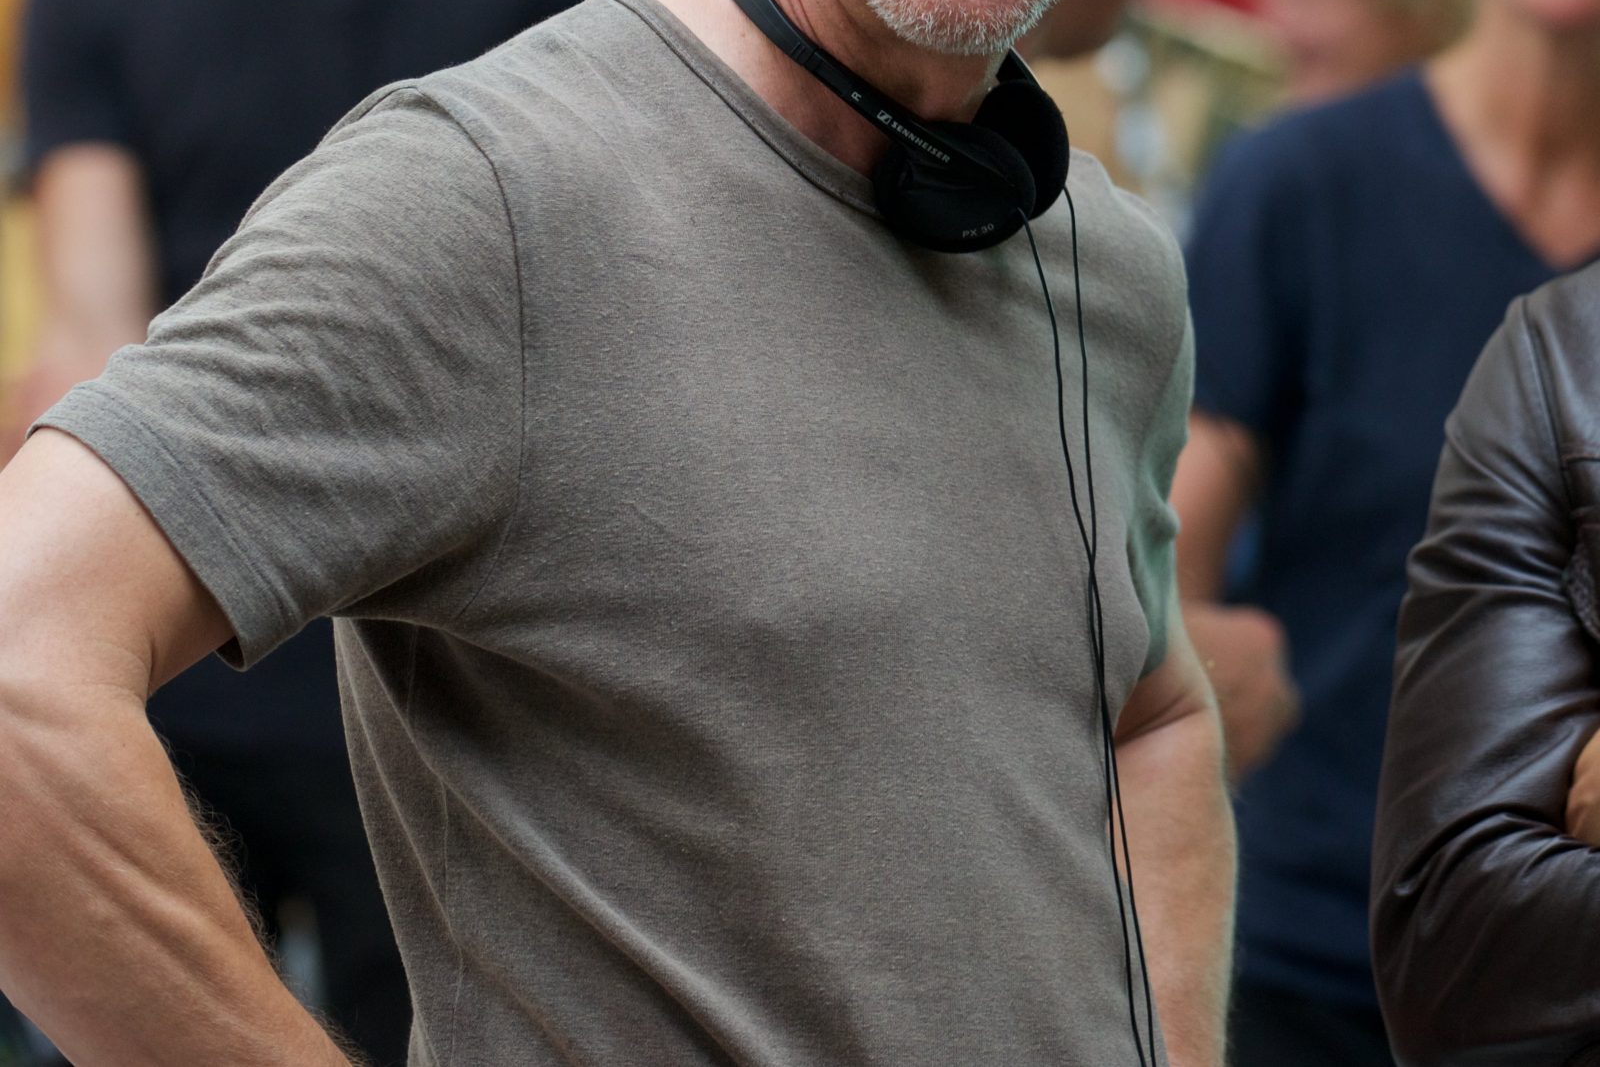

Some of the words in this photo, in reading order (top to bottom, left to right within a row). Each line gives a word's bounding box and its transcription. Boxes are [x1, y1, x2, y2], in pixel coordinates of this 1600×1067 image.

[850, 91, 862, 102] R
[891, 121, 951, 163] SENNHEISER
[962, 227, 977, 239] PX
